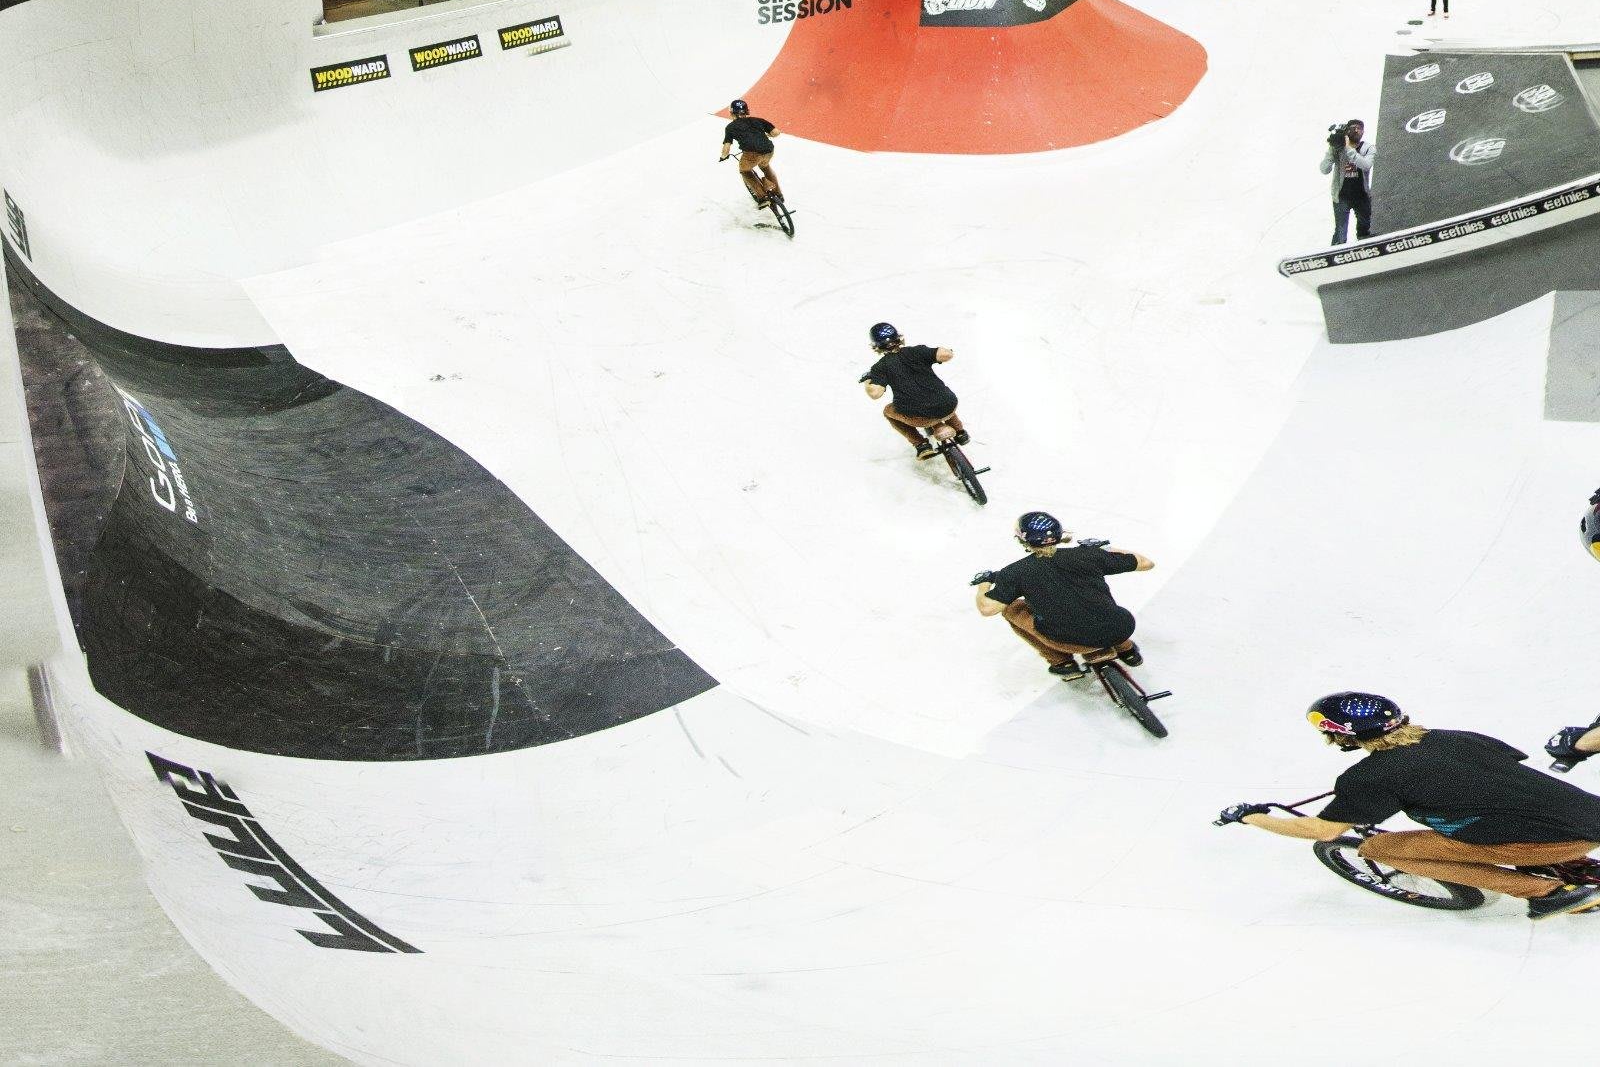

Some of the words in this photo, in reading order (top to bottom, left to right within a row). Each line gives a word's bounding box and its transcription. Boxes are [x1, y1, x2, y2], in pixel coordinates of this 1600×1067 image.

[502, 20, 560, 43] WOODWARD
[414, 40, 478, 63] WOODWARD
[316, 60, 386, 84] WOODWARD
[1553, 188, 1590, 209] etnies
[1501, 204, 1538, 224] etnies
[1450, 219, 1486, 239] etnies
[1395, 233, 1433, 251] etnies
[1292, 256, 1329, 273] etnies
[1344, 246, 1381, 264] etnies
